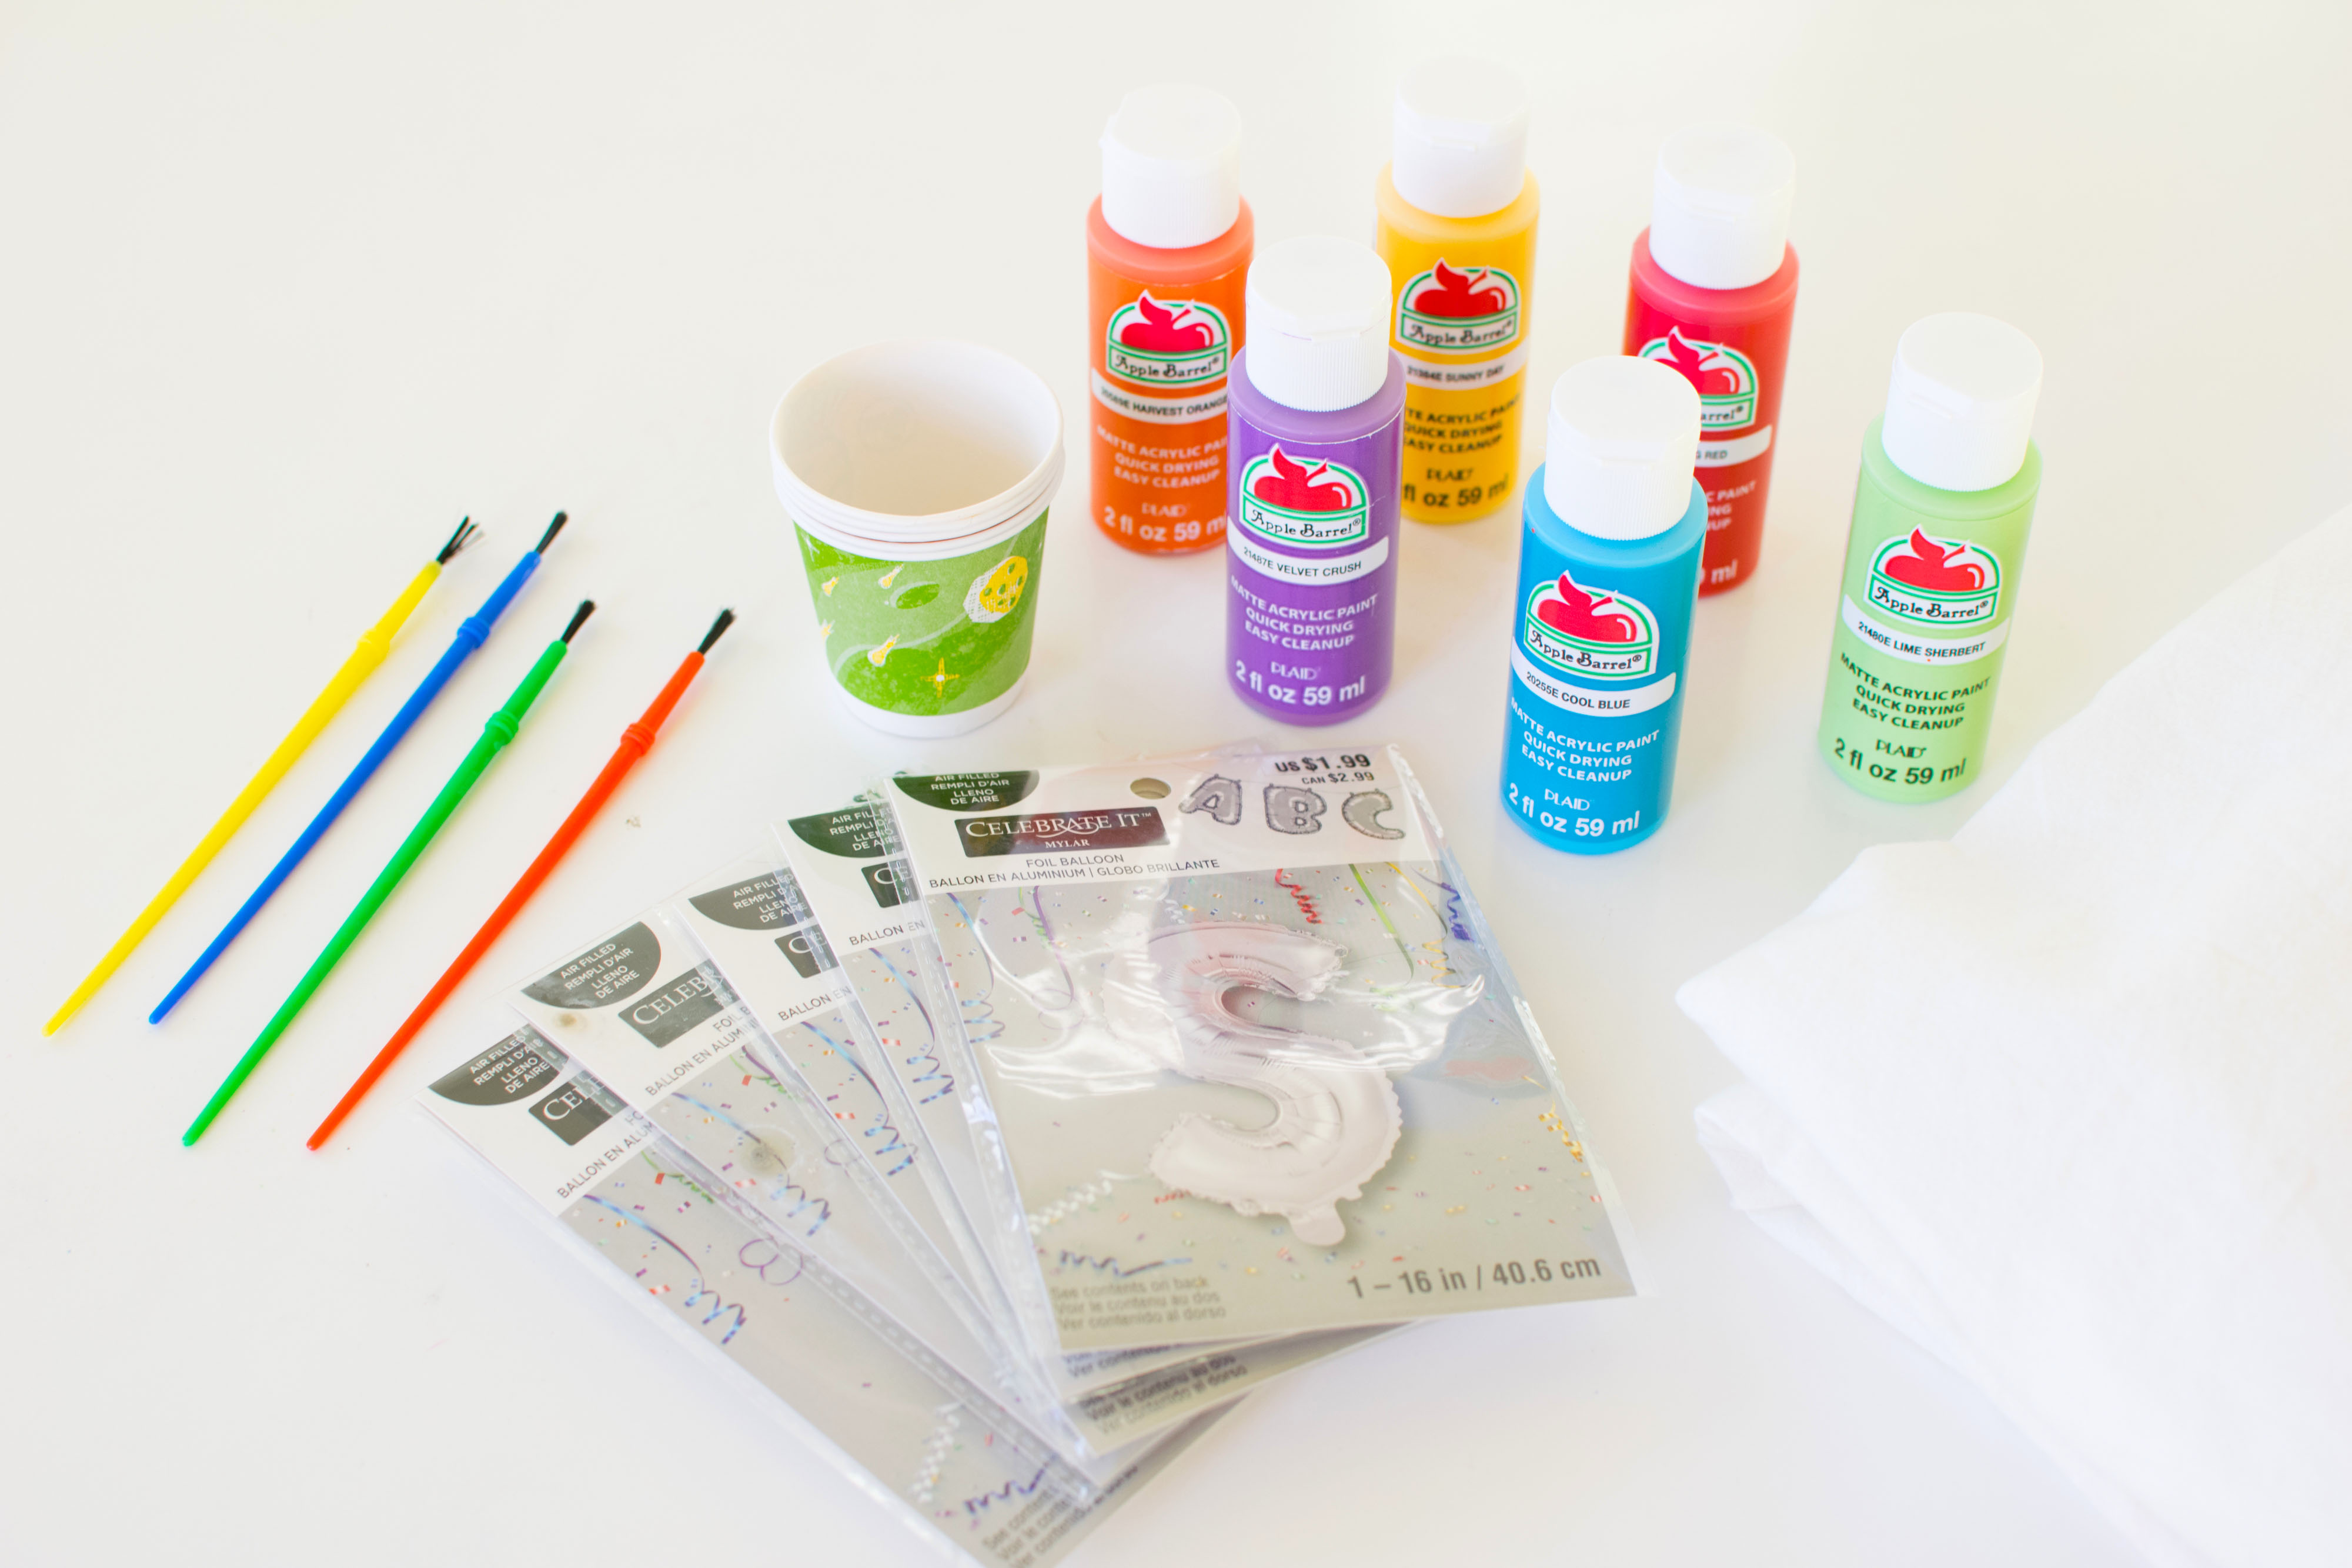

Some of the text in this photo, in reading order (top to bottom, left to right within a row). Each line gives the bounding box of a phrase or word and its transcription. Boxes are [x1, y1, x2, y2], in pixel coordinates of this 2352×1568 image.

[1410, 324, 1456, 345] Apple
[1115, 355, 1159, 377] Apple
[1446, 365, 1505, 382] SUNNY DAY
[1132, 403, 1183, 416] HARVEST
[1427, 412, 1487, 424] ACRYLIC
[1097, 425, 1201, 459] MATTE ACRYLIC
[1451, 421, 1502, 439] DRYING
[1439, 433, 1502, 453] CLEANUP
[1705, 450, 1728, 460] RED
[1115, 452, 1220, 474] QUICK DRYING
[1114, 466, 1220, 488] EASY CLEANUP
[1424, 492, 1449, 507] oz
[1456, 486, 1482, 506] 59
[1488, 472, 1509, 499] ml
[1718, 480, 1756, 502] PAINT
[1104, 506, 1201, 542] 2 fl oz 59
[1251, 509, 1296, 535] Apple
[1244, 547, 1362, 577] 21487E VELVET CRUSH
[1711, 559, 1738, 584] ml
[1231, 574, 1378, 621] MATTE ACRYLIC PAINT
[1875, 586, 1923, 614] Apple
[1246, 607, 1353, 636] QUICK DRYING
[1245, 620, 1354, 651] EASY CLEANUP
[1530, 630, 1573, 662] Apple
[1857, 621, 1986, 658] 21480E LIME SHERBERT
[1235, 659, 1365, 706] 2 fl oz 59 ml
[1271, 661, 1317, 680] PLAID
[1840, 652, 1990, 700] MATTE ACRYLIC PAINT
[1526, 671, 1631, 709] 20255E COOL BLUE
[1856, 684, 1965, 716] QUICK DRYING
[1511, 697, 1660, 753] MATTE ACRYLIC PAINT
[1852, 698, 1964, 730] EASY CLEANUP
[1524, 731, 1632, 767] QUICK DRYING
[1834, 737, 1967, 784] 2 fl oz 59 ml
[1875, 738, 1924, 758] PLAID
[1275, 753, 1372, 773] US $1.99
[1522, 744, 1632, 782] EASY CLEANUP
[931, 780, 1010, 791] REMPLI D'AIR
[958, 773, 1000, 781] FILLED
[1302, 771, 1375, 785] CAN $2.99
[954, 789, 994, 798] LLENO
[971, 795, 999, 804] AIRE
[1545, 788, 1590, 811] PLAID
[832, 814, 852, 824] AIR
[1509, 783, 1640, 837] 2 fl oz 59 ml
[830, 821, 873, 835] REMPLI
[965, 814, 1111, 838] CELEBRATE
[852, 841, 870, 851] DE
[1045, 839, 1090, 849] MYLAR
[930, 859, 1220, 888] BALLON EN ALUMINIUM GLOBO BRILLANTE
[1026, 854, 1124, 868] FOIL BALLOON
[733, 887, 753, 898] AIR
[733, 891, 776, 910] REMPLI
[760, 911, 778, 923] DE
[849, 920, 926, 945] BALLON EN
[560, 943, 616, 979] AIR FILLED
[564, 947, 634, 991] REMPLI D'AIR
[591, 965, 629, 989] LLENO
[595, 969, 640, 999] DE AIRE
[778, 985, 852, 1021] BALLON EN
[713, 1013, 743, 1032] FOIL
[470, 1059, 490, 1074] AIR
[474, 1057, 514, 1085] REMPLI
[501, 1057, 538, 1083] LLENO
[505, 1061, 550, 1094] DE AIRE
[645, 1050, 712, 1096] BALLON EN
[557, 1145, 624, 1199] BALLON EN
[1347, 1258, 1602, 1298] 1 16 in 40.6 cm
